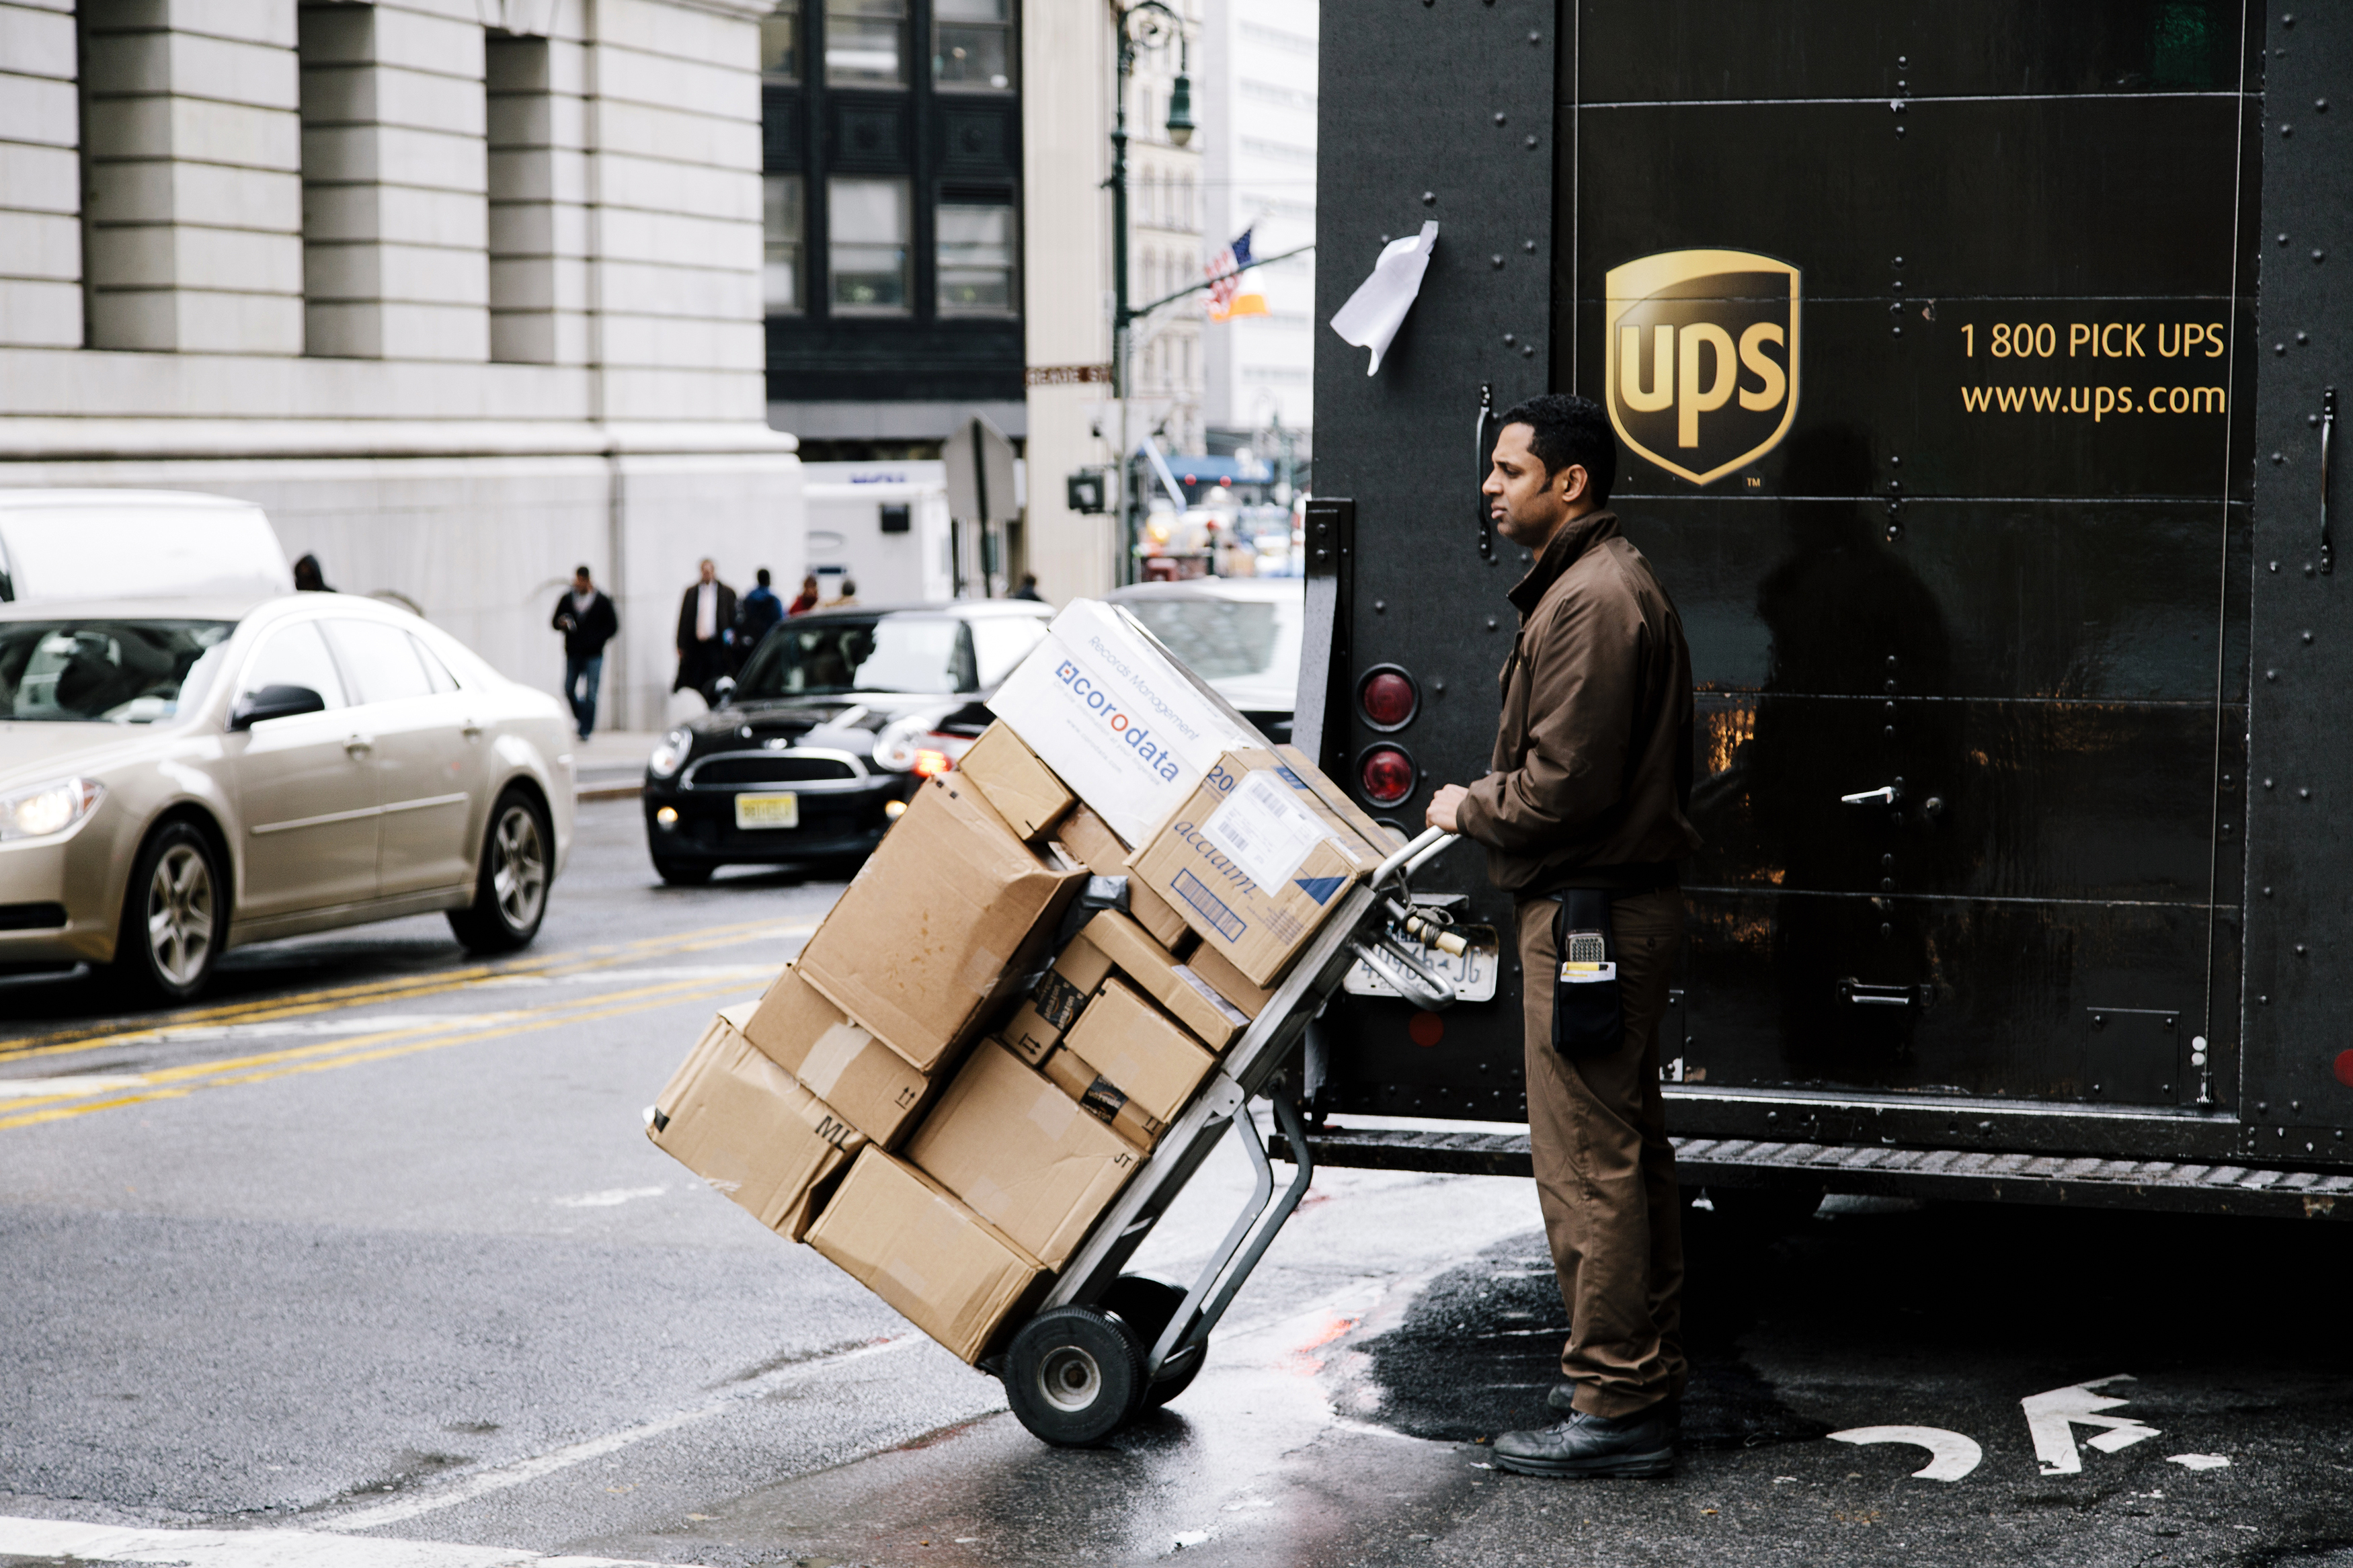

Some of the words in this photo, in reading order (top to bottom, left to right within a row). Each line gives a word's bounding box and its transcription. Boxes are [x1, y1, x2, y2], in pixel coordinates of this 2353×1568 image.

[1960, 323, 1974, 358] 1
[1991, 323, 2057, 358] 800
[2069, 323, 2146, 358] PICK
[2158, 323, 2225, 358] UPS
[1621, 322, 1786, 447] ups
[1960, 386, 2226, 423] www.ups.com
[1088, 635, 1131, 677] Records
[1129, 674, 1200, 741] Management
[1073, 677, 1179, 782] corodata
[1208, 766, 1237, 794] 20
[1058, 995, 1075, 1030] amazon
